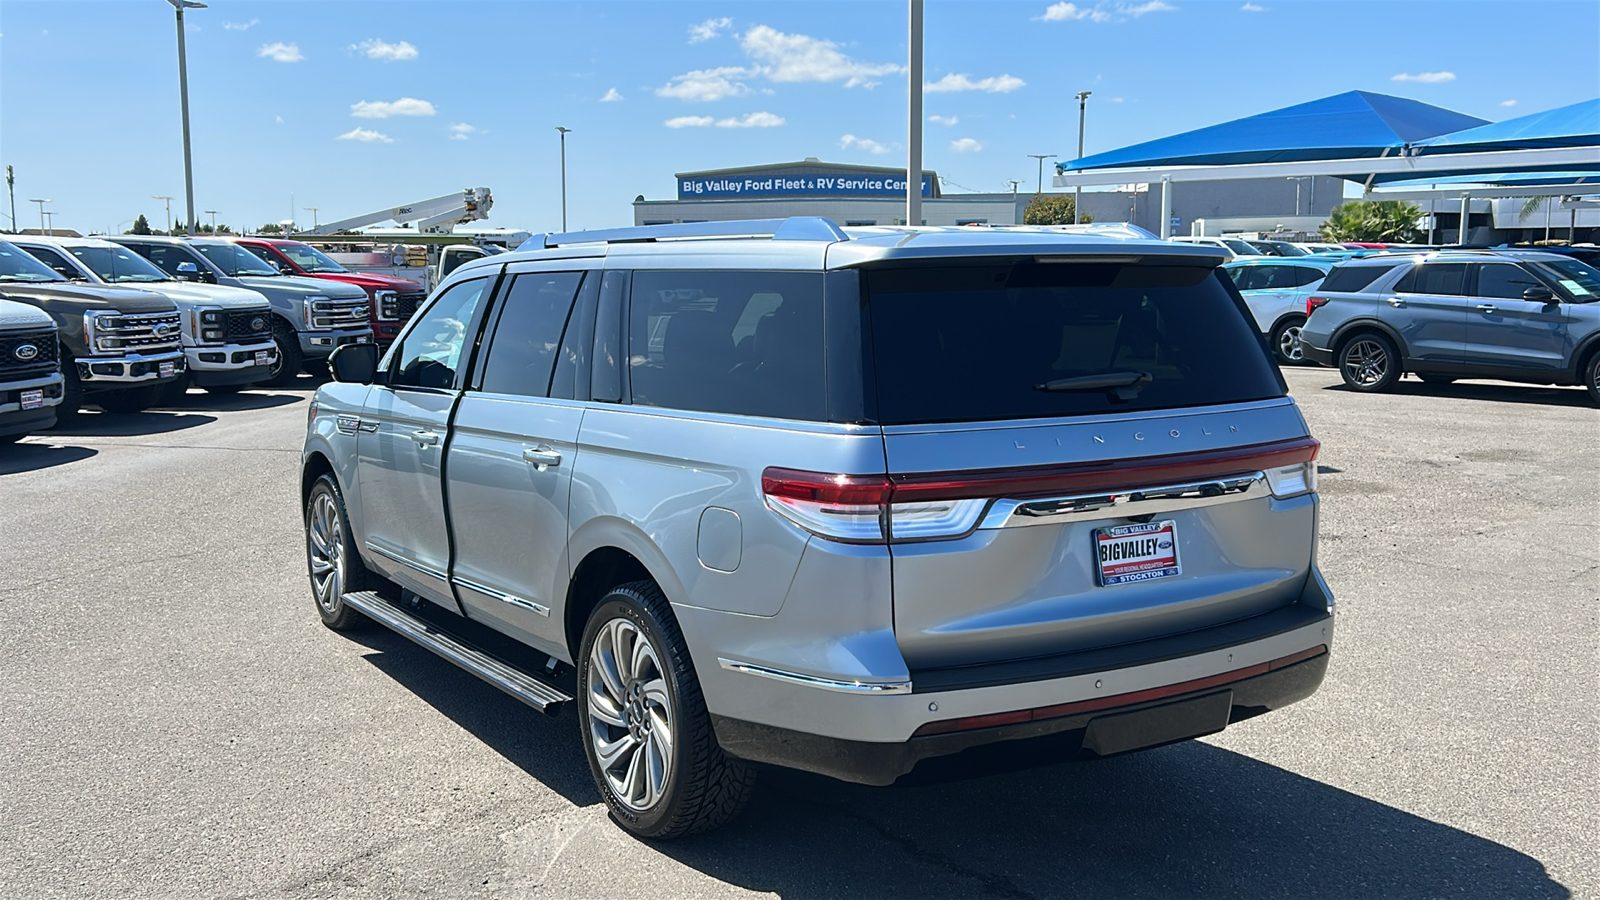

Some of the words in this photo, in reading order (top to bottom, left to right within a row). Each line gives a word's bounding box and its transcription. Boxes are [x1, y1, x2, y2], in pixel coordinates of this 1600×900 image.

[683, 182, 703, 193] Big
[705, 181, 742, 192] Valley
[745, 180, 772, 190] Ford
[775, 179, 805, 189] Fleet
[807, 181, 815, 189] &
[816, 178, 834, 189] RV
[836, 178, 882, 190] Service
[884, 179, 926, 190] Cenr
[1014, 425, 1239, 449] LINCOLN
[1115, 527, 1128, 535] BIG
[1130, 524, 1156, 533] VALLEY
[1101, 538, 1158, 561] BIGVALLEY
[1120, 570, 1163, 582] STOCKTON
